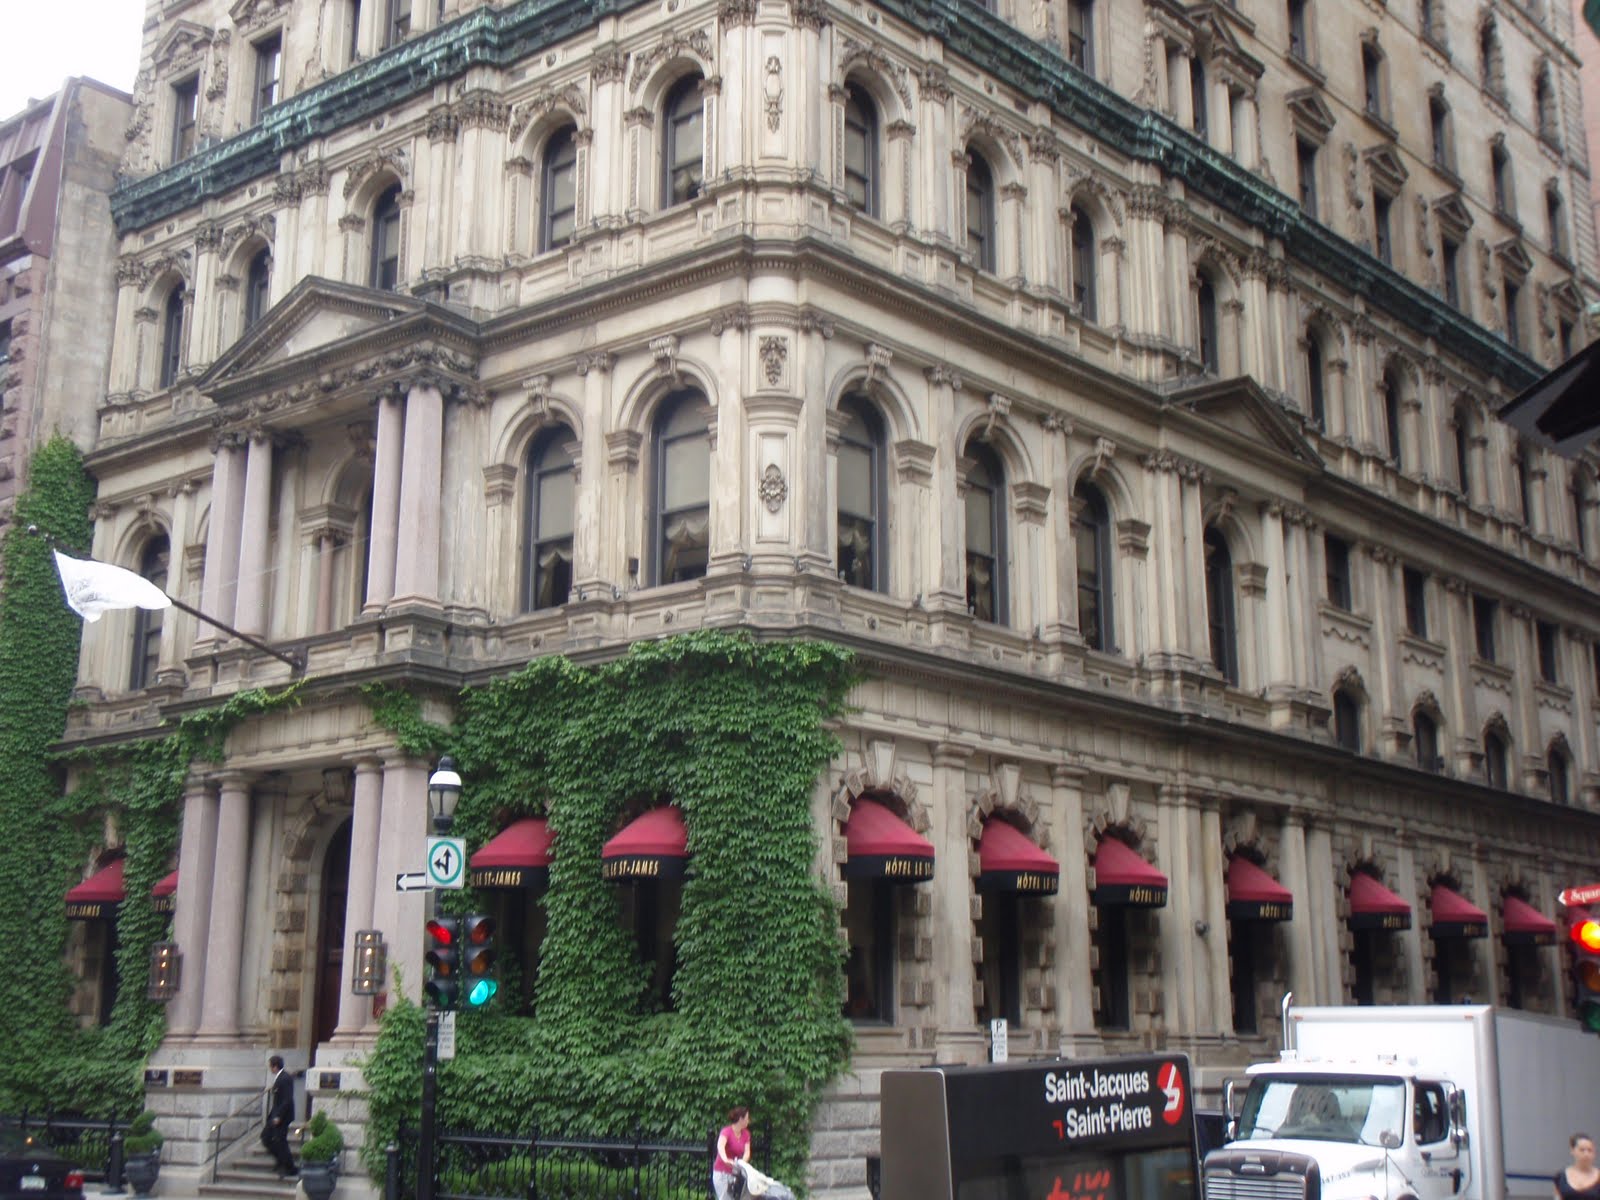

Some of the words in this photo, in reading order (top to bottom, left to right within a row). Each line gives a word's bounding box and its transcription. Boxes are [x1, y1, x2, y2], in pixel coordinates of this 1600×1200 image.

[885, 856, 911, 876] HÔTEL
[1016, 871, 1041, 890] HÔTEL
[1129, 885, 1152, 904] HÔTEL
[1045, 1068, 1150, 1103] Saint-Jacques
[1066, 1102, 1152, 1139] Saint-Pierre
